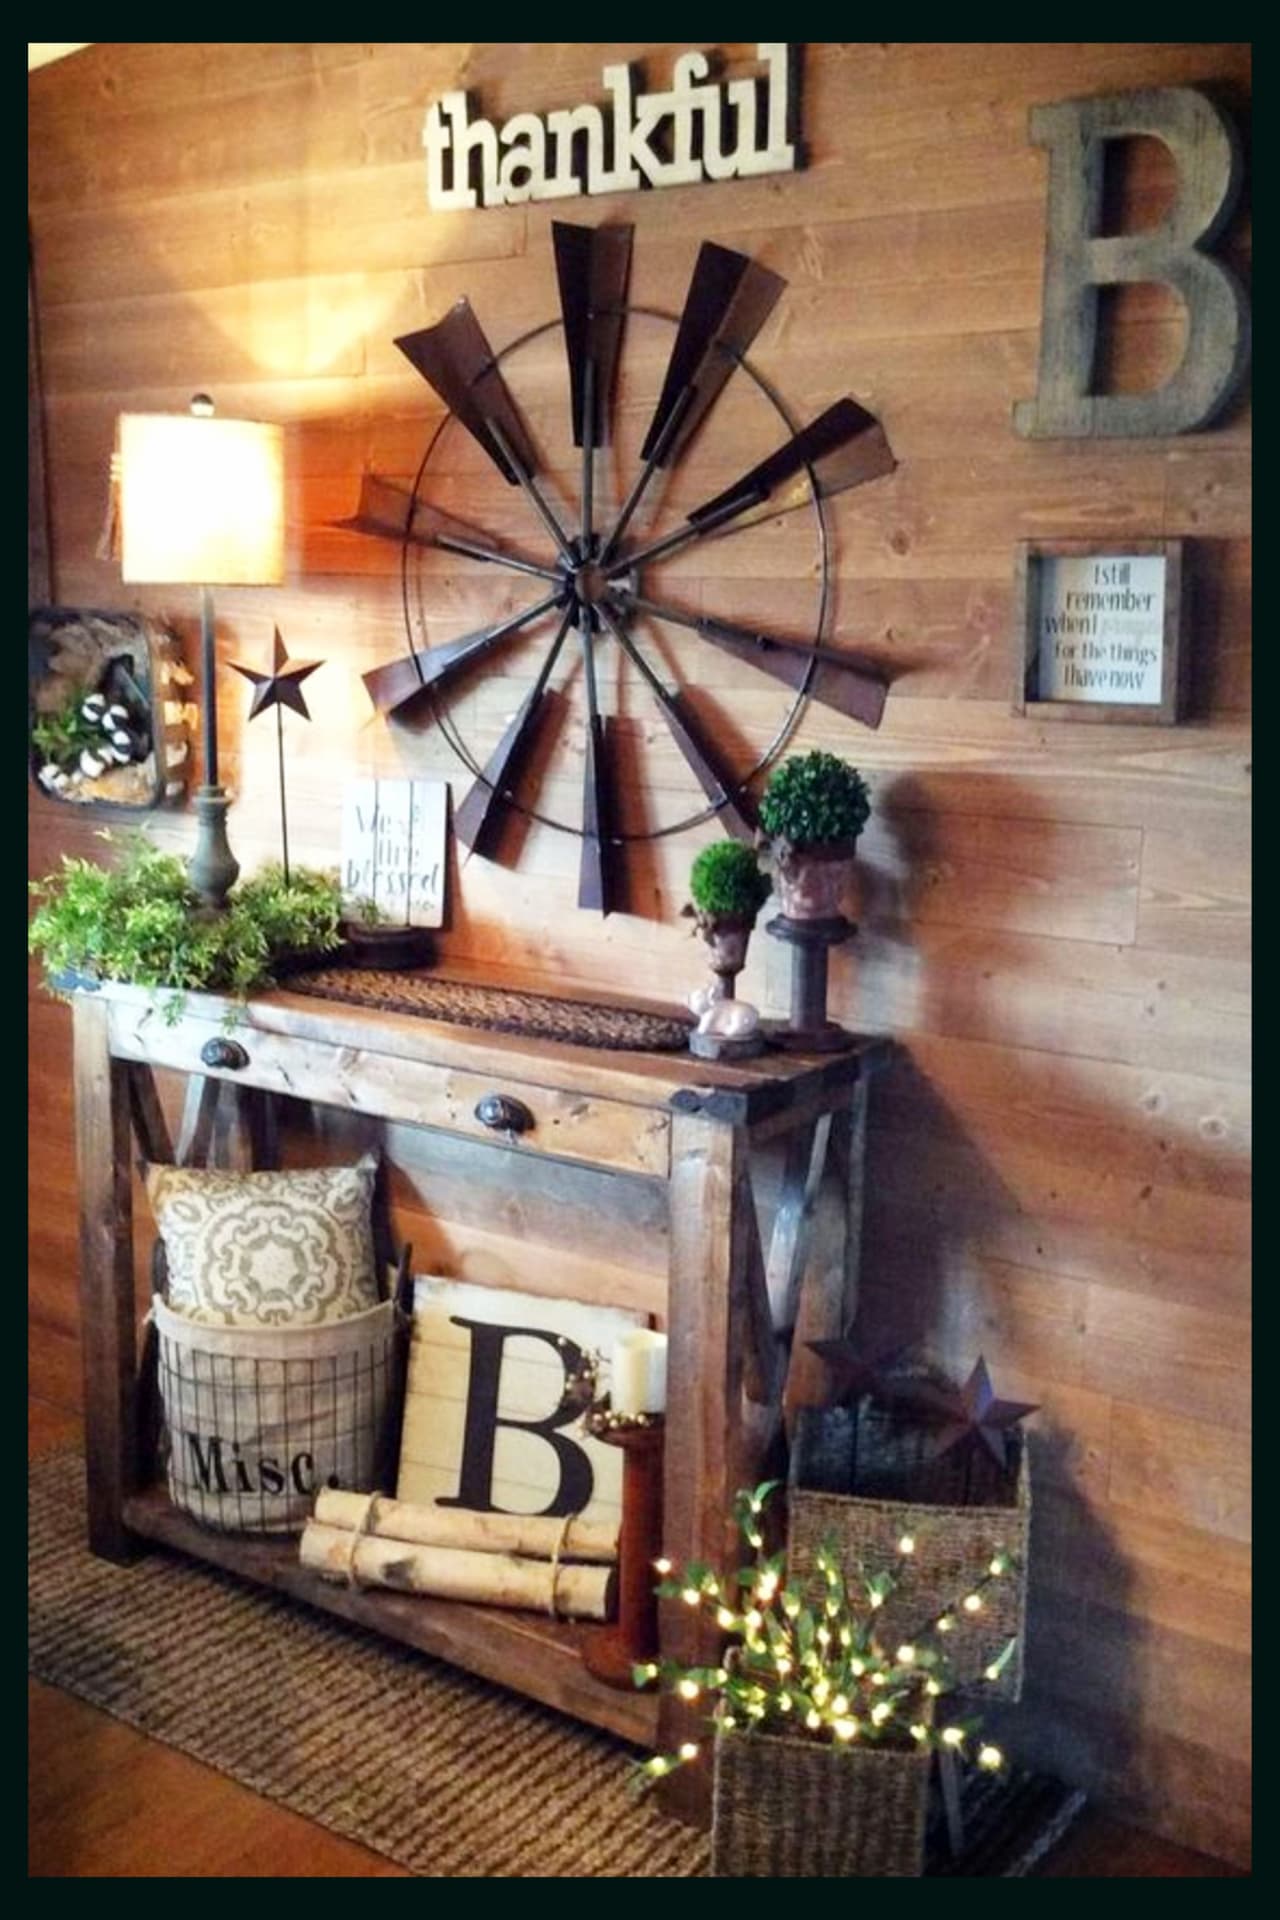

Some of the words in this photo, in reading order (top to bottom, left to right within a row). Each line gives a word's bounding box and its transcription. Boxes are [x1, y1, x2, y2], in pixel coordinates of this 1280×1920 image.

[423, 43, 794, 211] thankful
[1012, 86, 1242, 440] B
[1102, 562, 1131, 585] still
[1066, 588, 1153, 610] remember
[1045, 611, 1091, 634] when
[1055, 641, 1077, 659] for
[1082, 642, 1106, 661] the
[1110, 643, 1158, 667] things
[1070, 664, 1108, 688] have
[1109, 669, 1145, 689] now
[435, 1315, 595, 1518] B
[187, 1433, 340, 1497] Misc.
